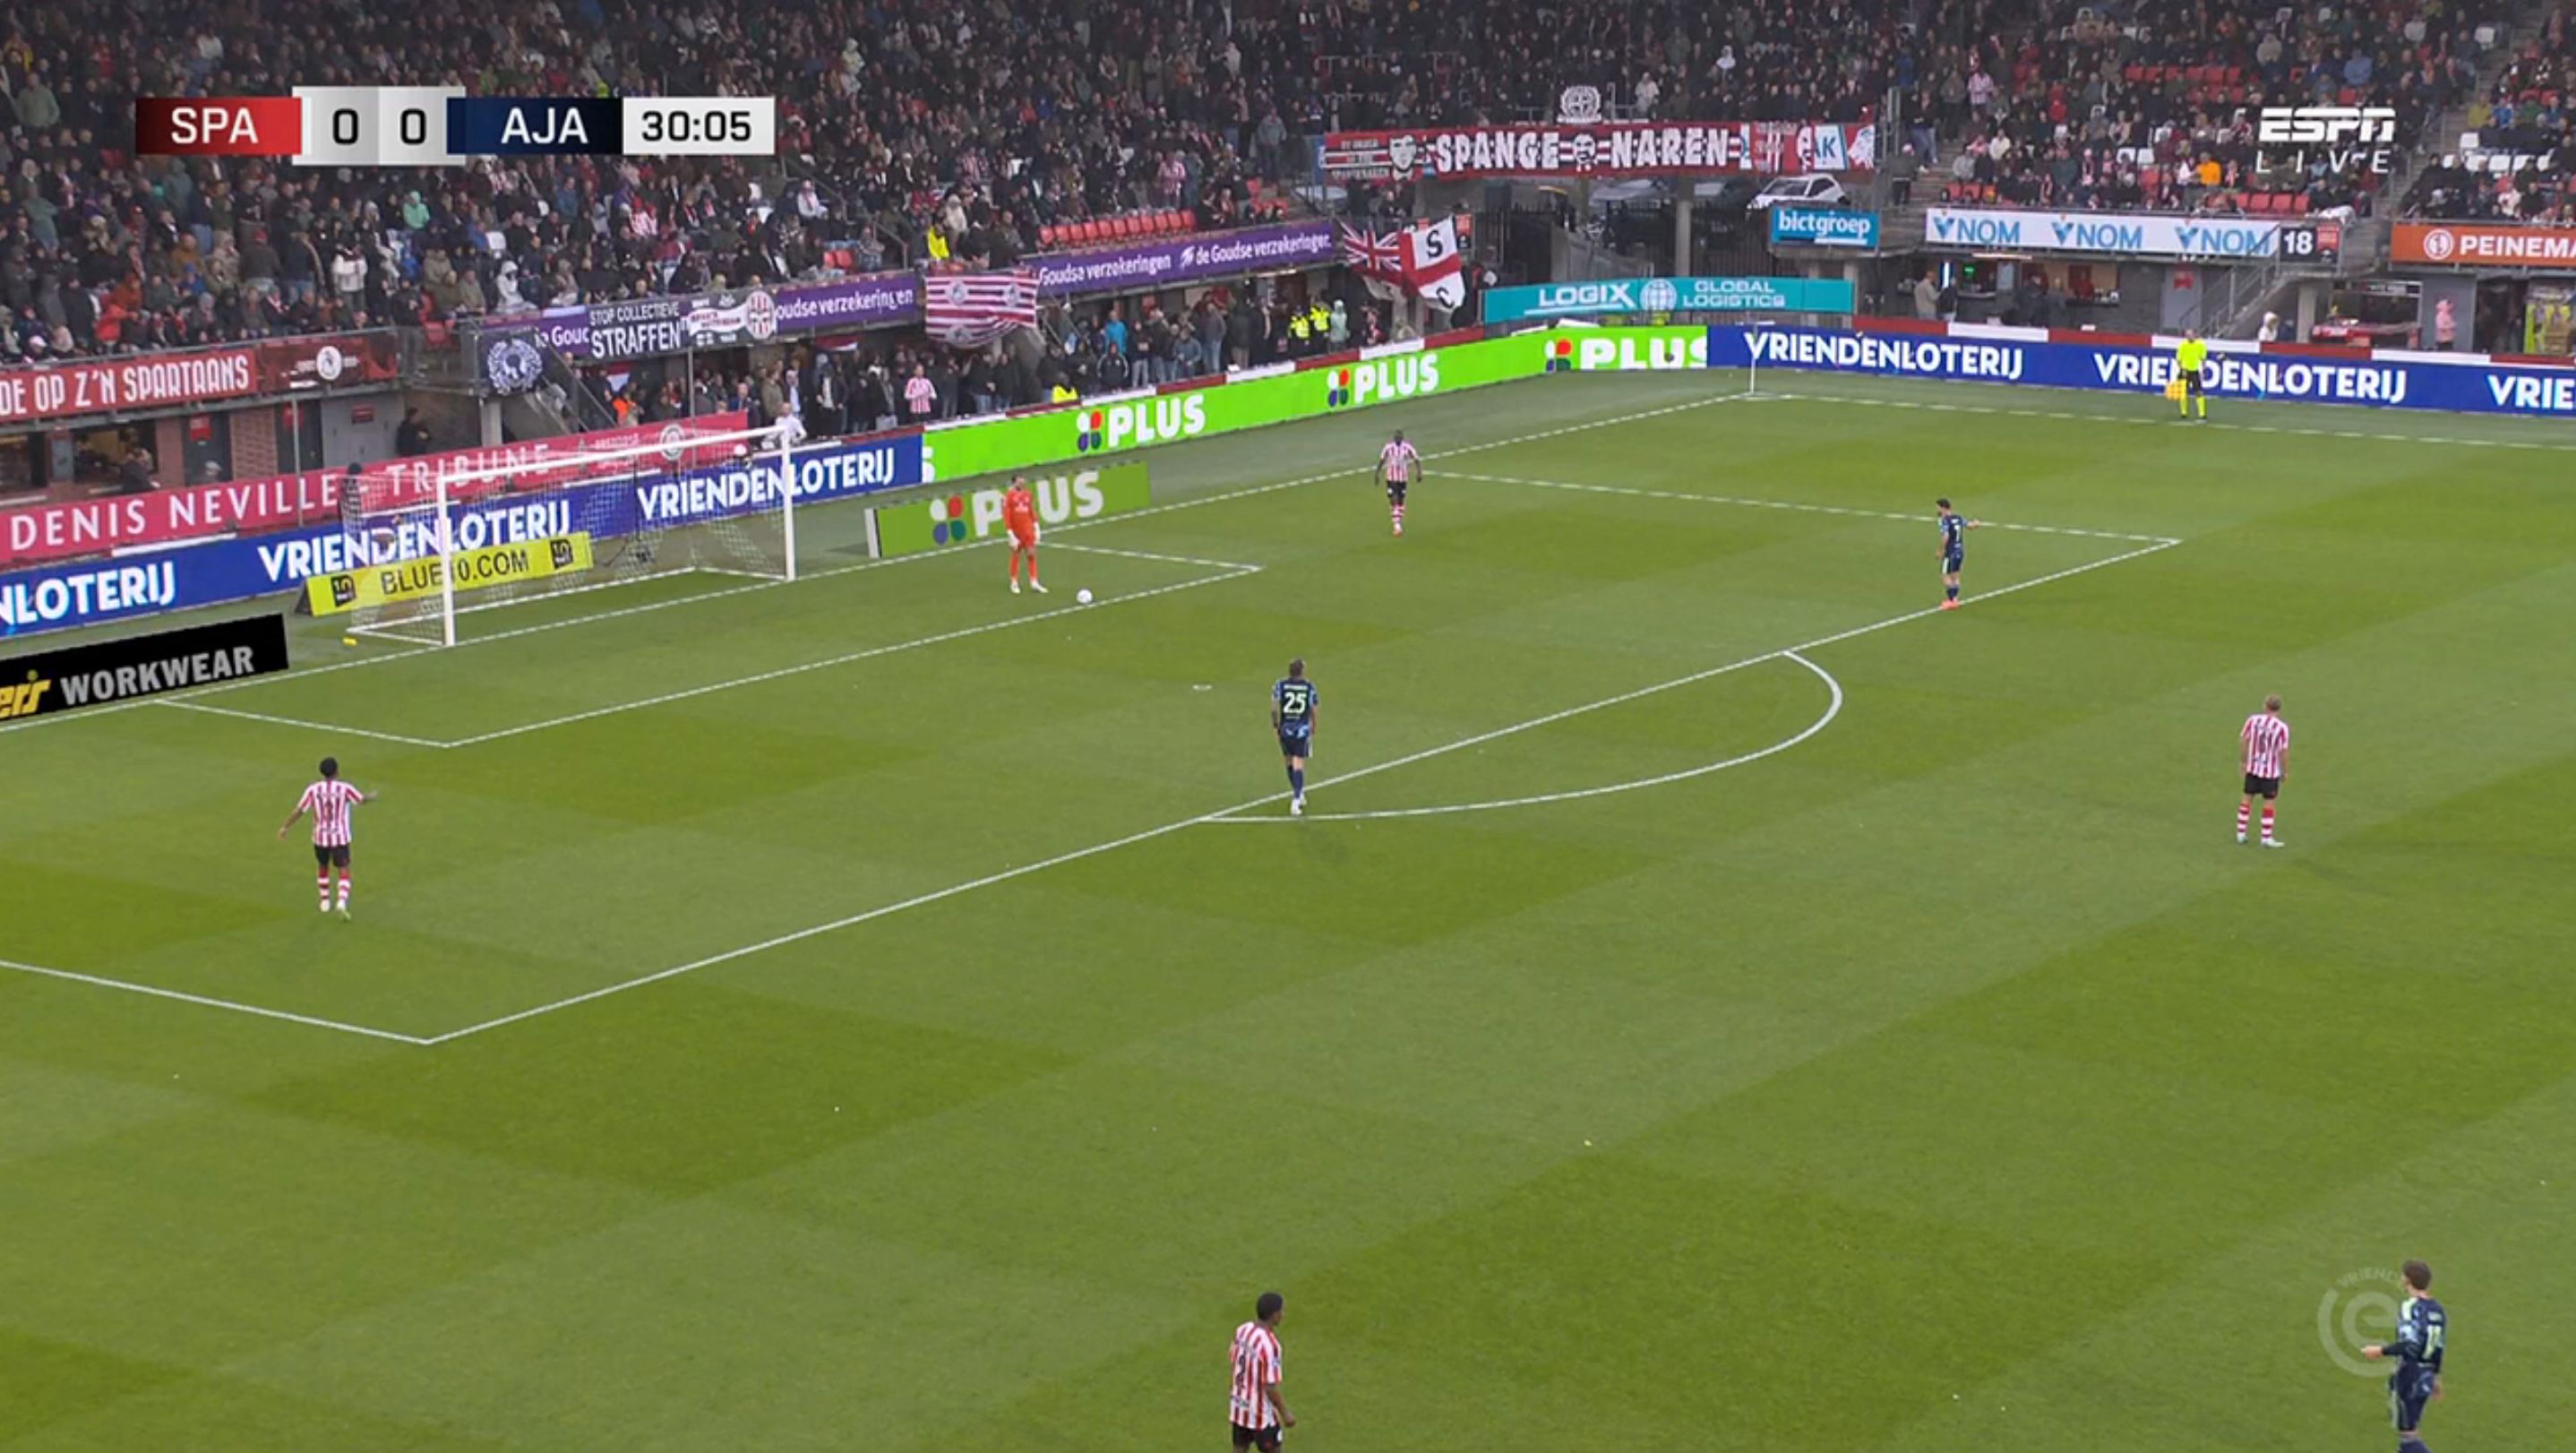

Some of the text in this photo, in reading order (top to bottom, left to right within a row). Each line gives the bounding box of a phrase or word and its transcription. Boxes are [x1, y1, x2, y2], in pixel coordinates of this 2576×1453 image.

[1435, 131, 1559, 172] SPANGE
[1196, 245, 1210, 266] de
[1211, 240, 1253, 263] Goudse
[1426, 228, 1443, 259] S
[2284, 229, 2314, 255] 18
[1086, 254, 1172, 280] verzekeringen
[1539, 283, 1636, 309] LOGIX
[1683, 293, 1786, 308] LOGISTICS
[1694, 280, 1775, 294] GLOBAL
[589, 307, 614, 327] STOP
[590, 321, 682, 358] STRAFFEN
[1744, 332, 2023, 380] VRIENDENLOTERIJ
[34, 374, 66, 412] OP
[74, 368, 116, 408] Z'N
[124, 355, 250, 405] SPARTAANS
[1354, 353, 1440, 404] PLUS
[1108, 394, 1206, 447] PLUS
[11, 498, 147, 551] DENIS
[170, 474, 339, 529] NEVILLE
[972, 471, 1104, 537] PUS
[381, 548, 528, 596] BLUE0.COM
[60, 646, 255, 706] WORKWEAR
[1283, 692, 1308, 714] 25
